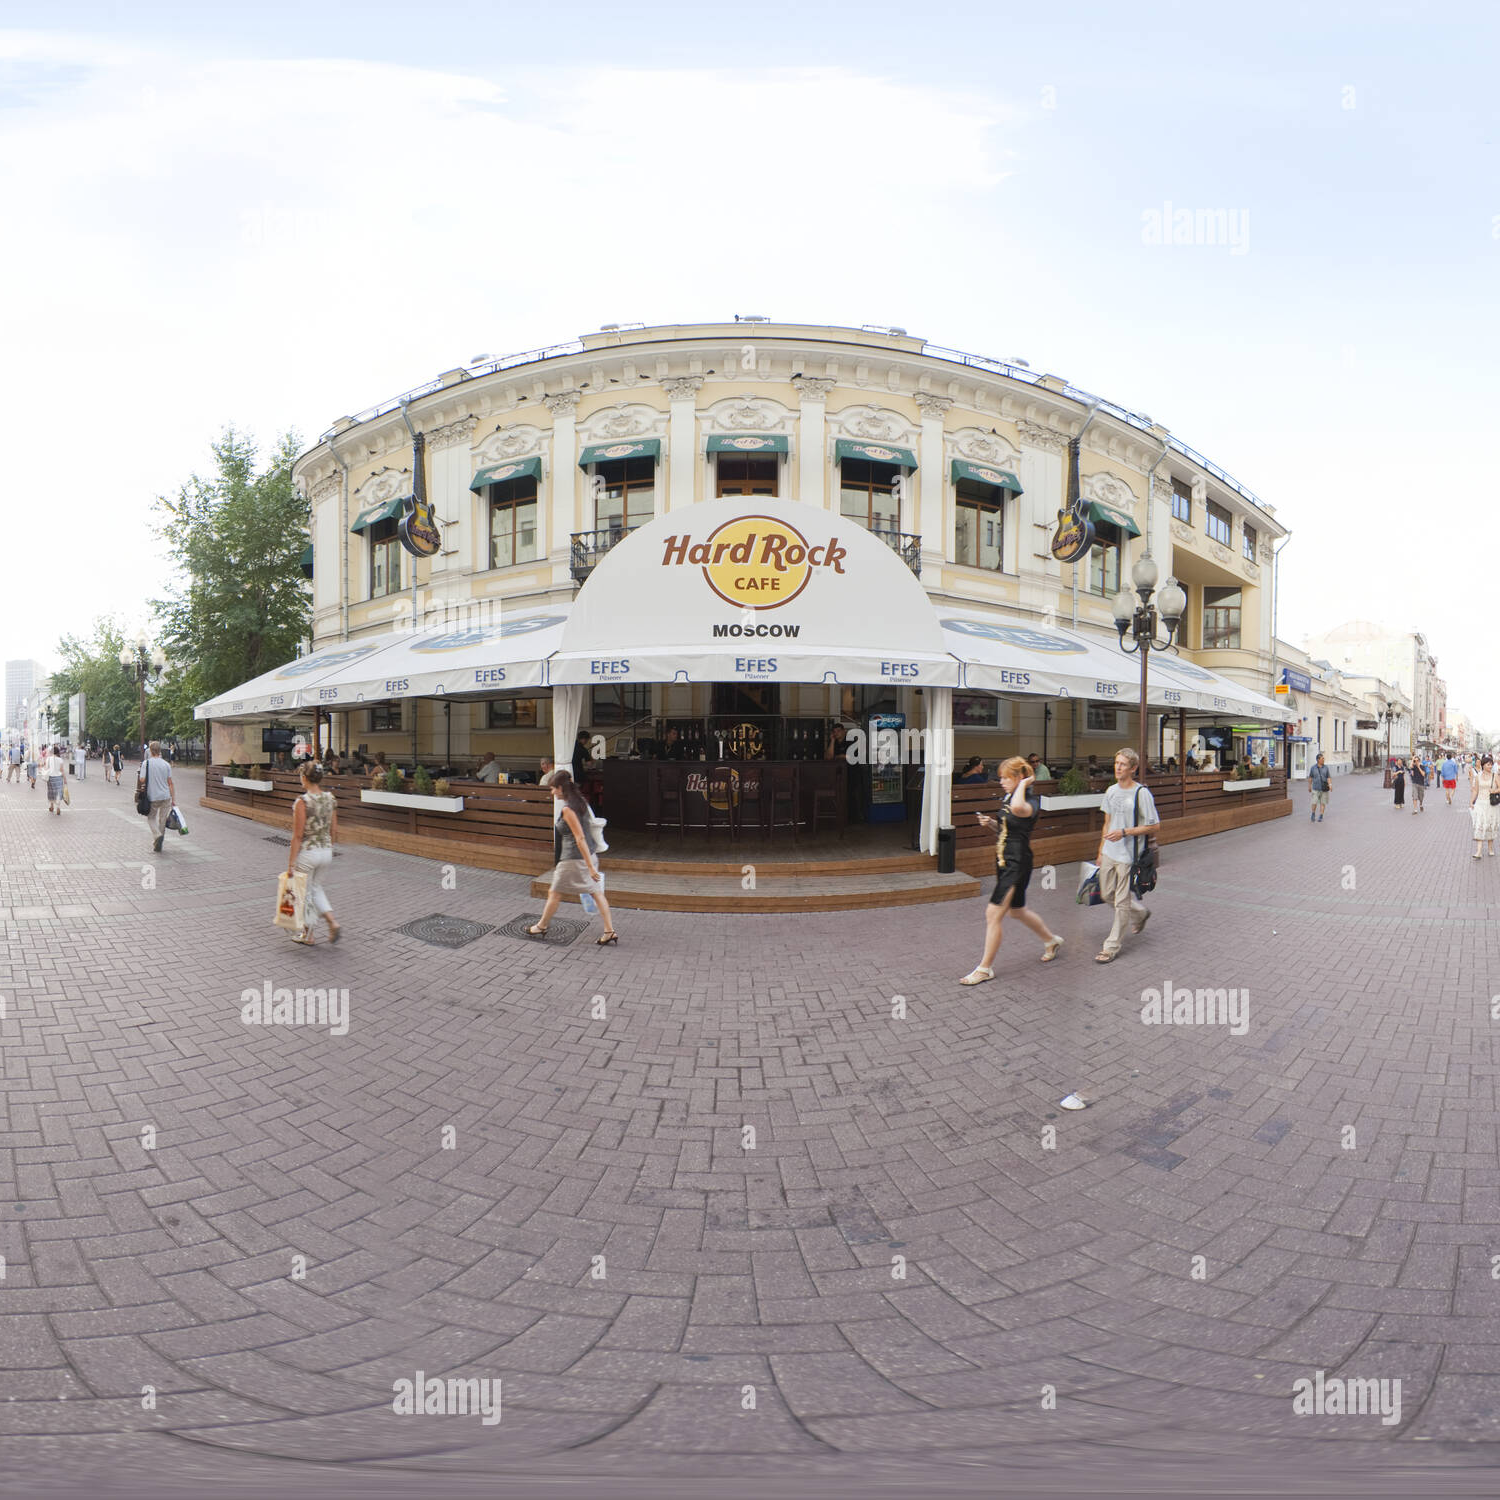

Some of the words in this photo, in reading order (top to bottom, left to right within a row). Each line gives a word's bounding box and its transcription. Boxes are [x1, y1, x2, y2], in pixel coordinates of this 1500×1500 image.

[662, 534, 756, 566] Hard
[760, 534, 847, 574] Rock
[734, 577, 780, 590] CAFE
[713, 624, 800, 638] MOSCOW
[590, 659, 630, 674] EFES
[735, 658, 777, 673] EFES
[881, 662, 919, 677] EFES
[475, 668, 506, 682] EFES
[1001, 670, 1030, 685] EFES
[386, 679, 409, 692] EFES
[1096, 682, 1118, 695] EFES
[320, 688, 338, 698] EFES
[1164, 690, 1181, 701] EFES
